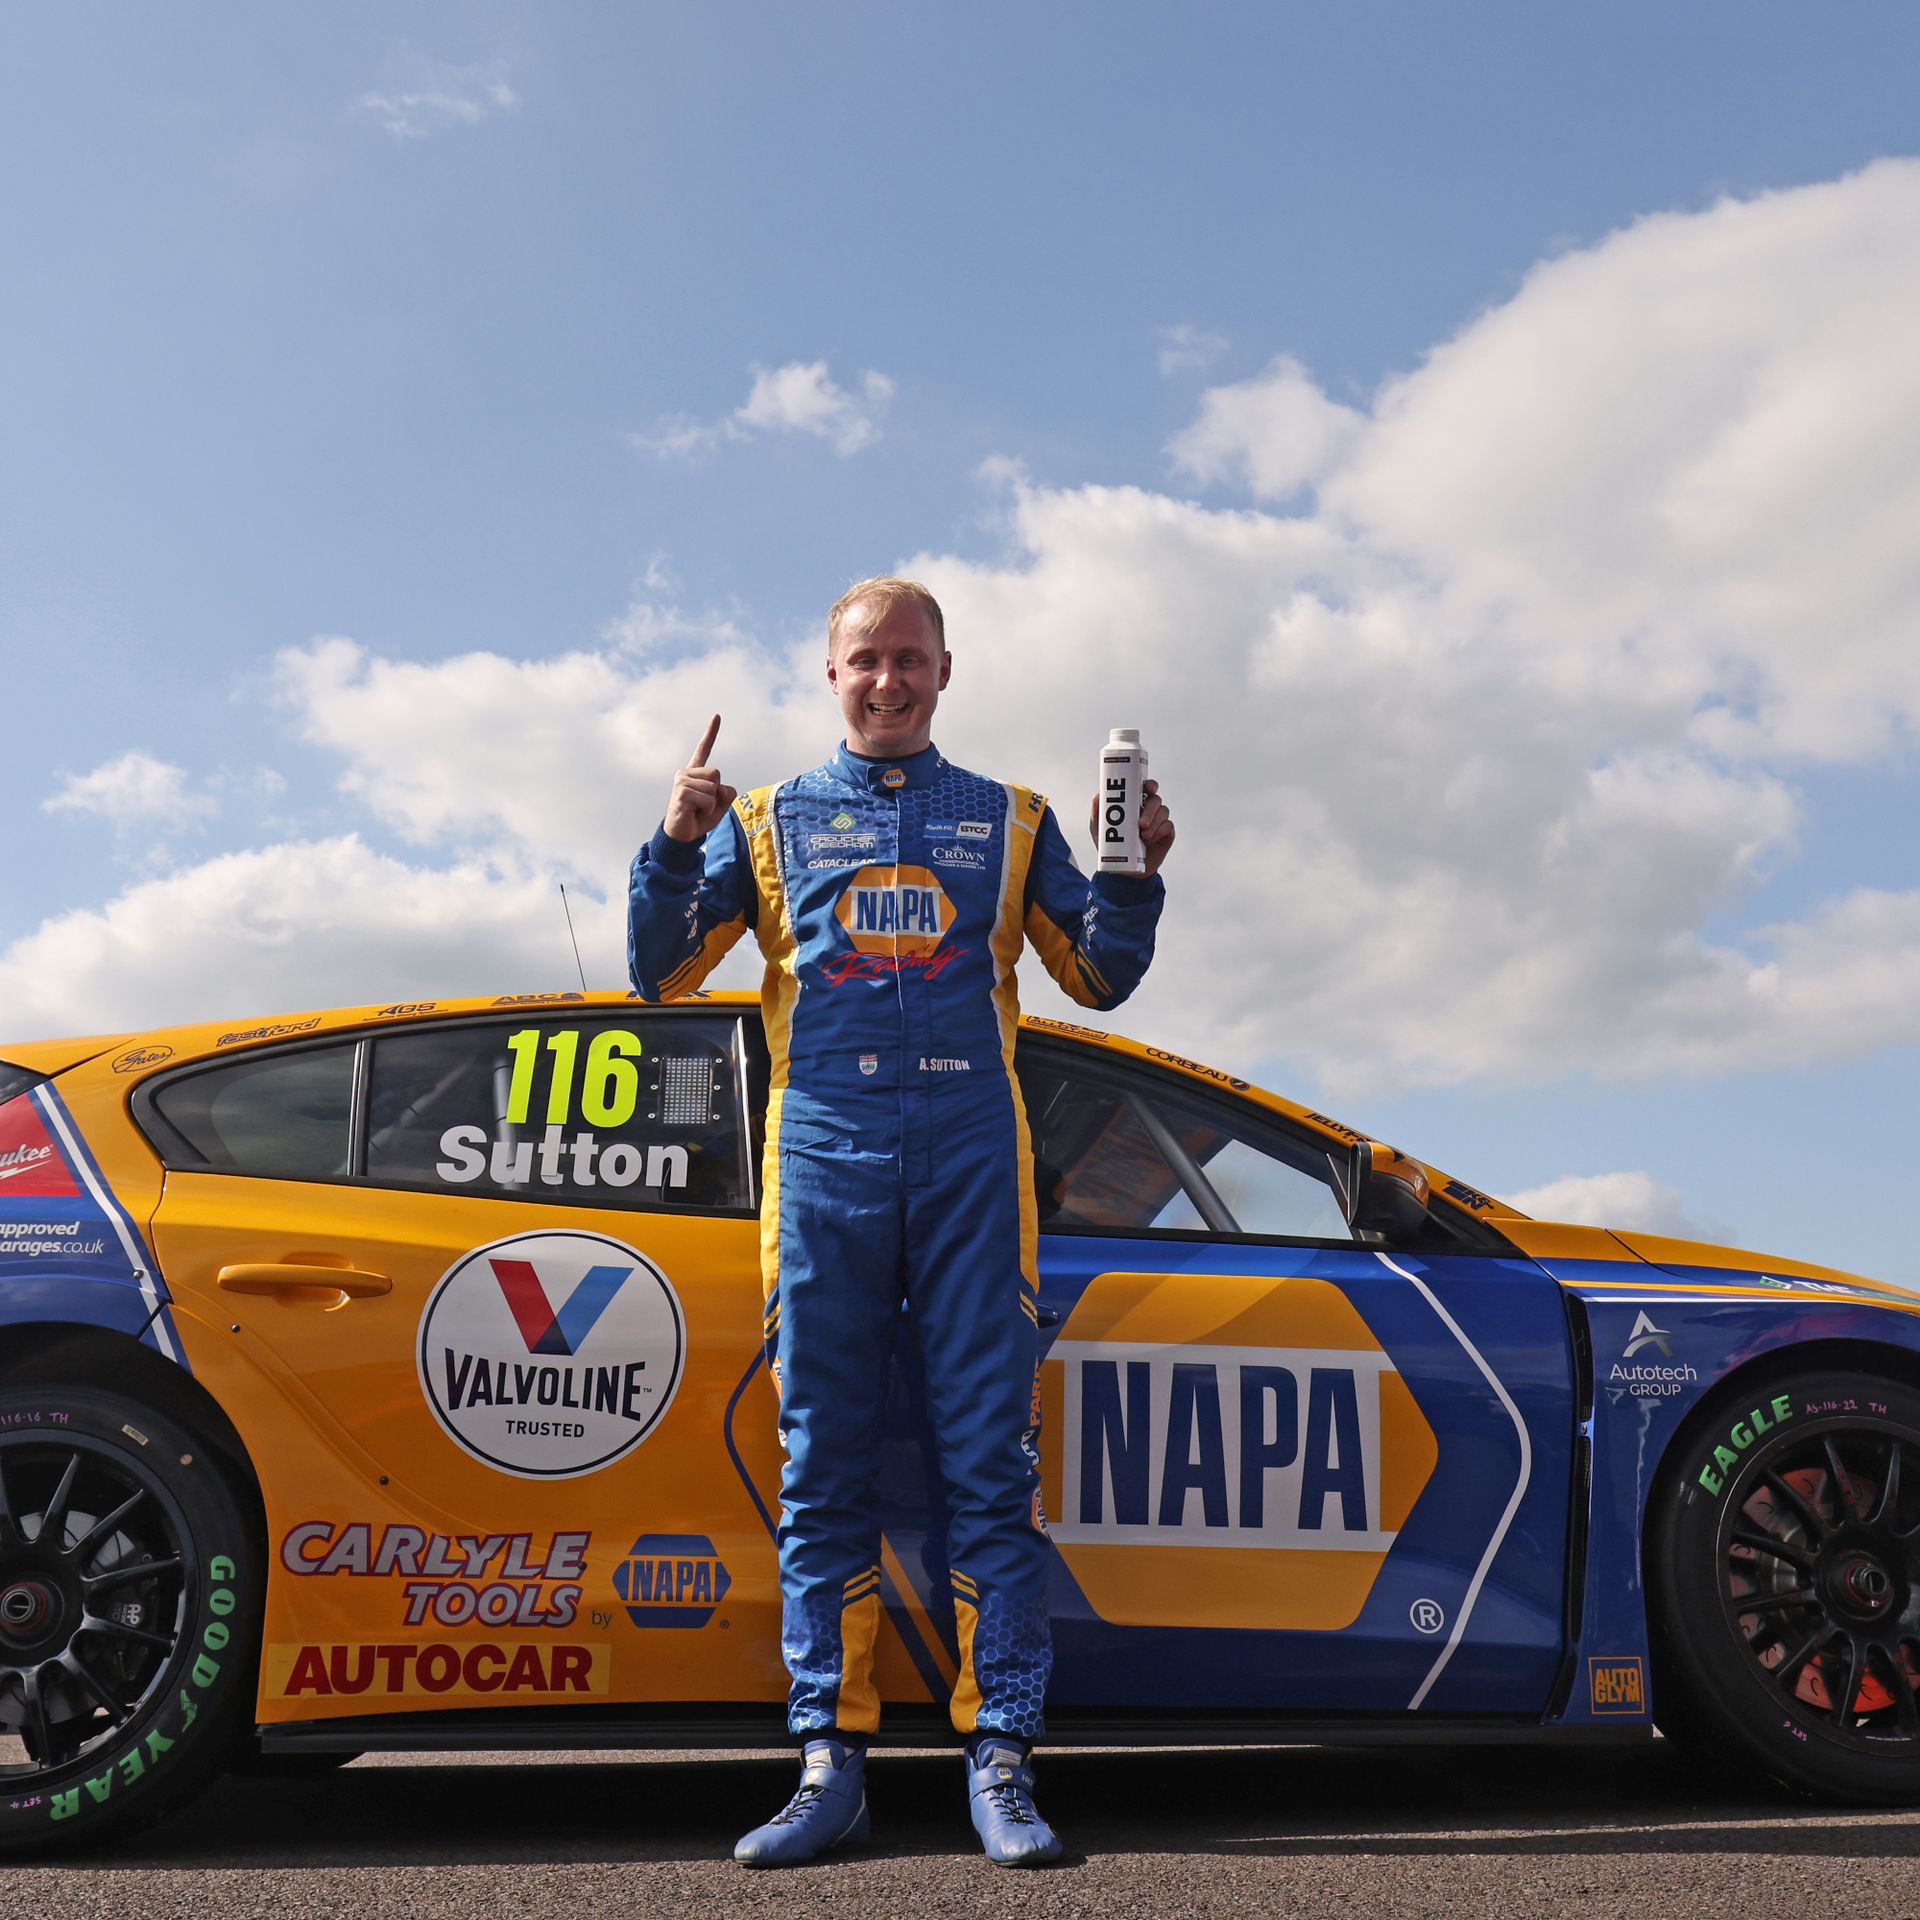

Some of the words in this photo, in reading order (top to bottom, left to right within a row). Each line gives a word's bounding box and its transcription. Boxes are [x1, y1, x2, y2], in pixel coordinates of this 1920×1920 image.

[1105, 778, 1126, 843] POLE
[810, 835, 876, 844] CROUCHER
[960, 825, 988, 835] BTCC
[807, 858, 877, 870] CATACLEAN
[932, 848, 985, 862] CROWN
[857, 888, 938, 934] NAPA
[821, 944, 969, 988] Racing
[377, 1003, 437, 1017] AGS
[216, 1017, 322, 1047] fastford
[505, 1029, 642, 1128] 116
[1146, 1047, 1229, 1083] CORBEAU
[436, 1124, 689, 1188] Sutton
[0, 1221, 80, 1239] approved
[445, 1347, 646, 1422] VALVOLINE
[1610, 1363, 1698, 1382] Autotech
[1629, 1384, 1681, 1396] GROUP
[50, 1411, 69, 1425] TH
[506, 1420, 585, 1438] TRUSTED
[1079, 1360, 1368, 1532] NAPA
[1699, 1394, 1794, 1497] EAGLE
[280, 1520, 593, 1579] CARLYLE
[402, 1582, 584, 1628] TOOLS
[592, 1608, 613, 1629] by
[631, 1559, 714, 1603] NAPA
[284, 1643, 594, 1696] AUTOCAR
[1594, 1667, 1639, 1686] AUTO
[1594, 1684, 1641, 1703] GLYM
[22, 1795, 41, 1808] SET
